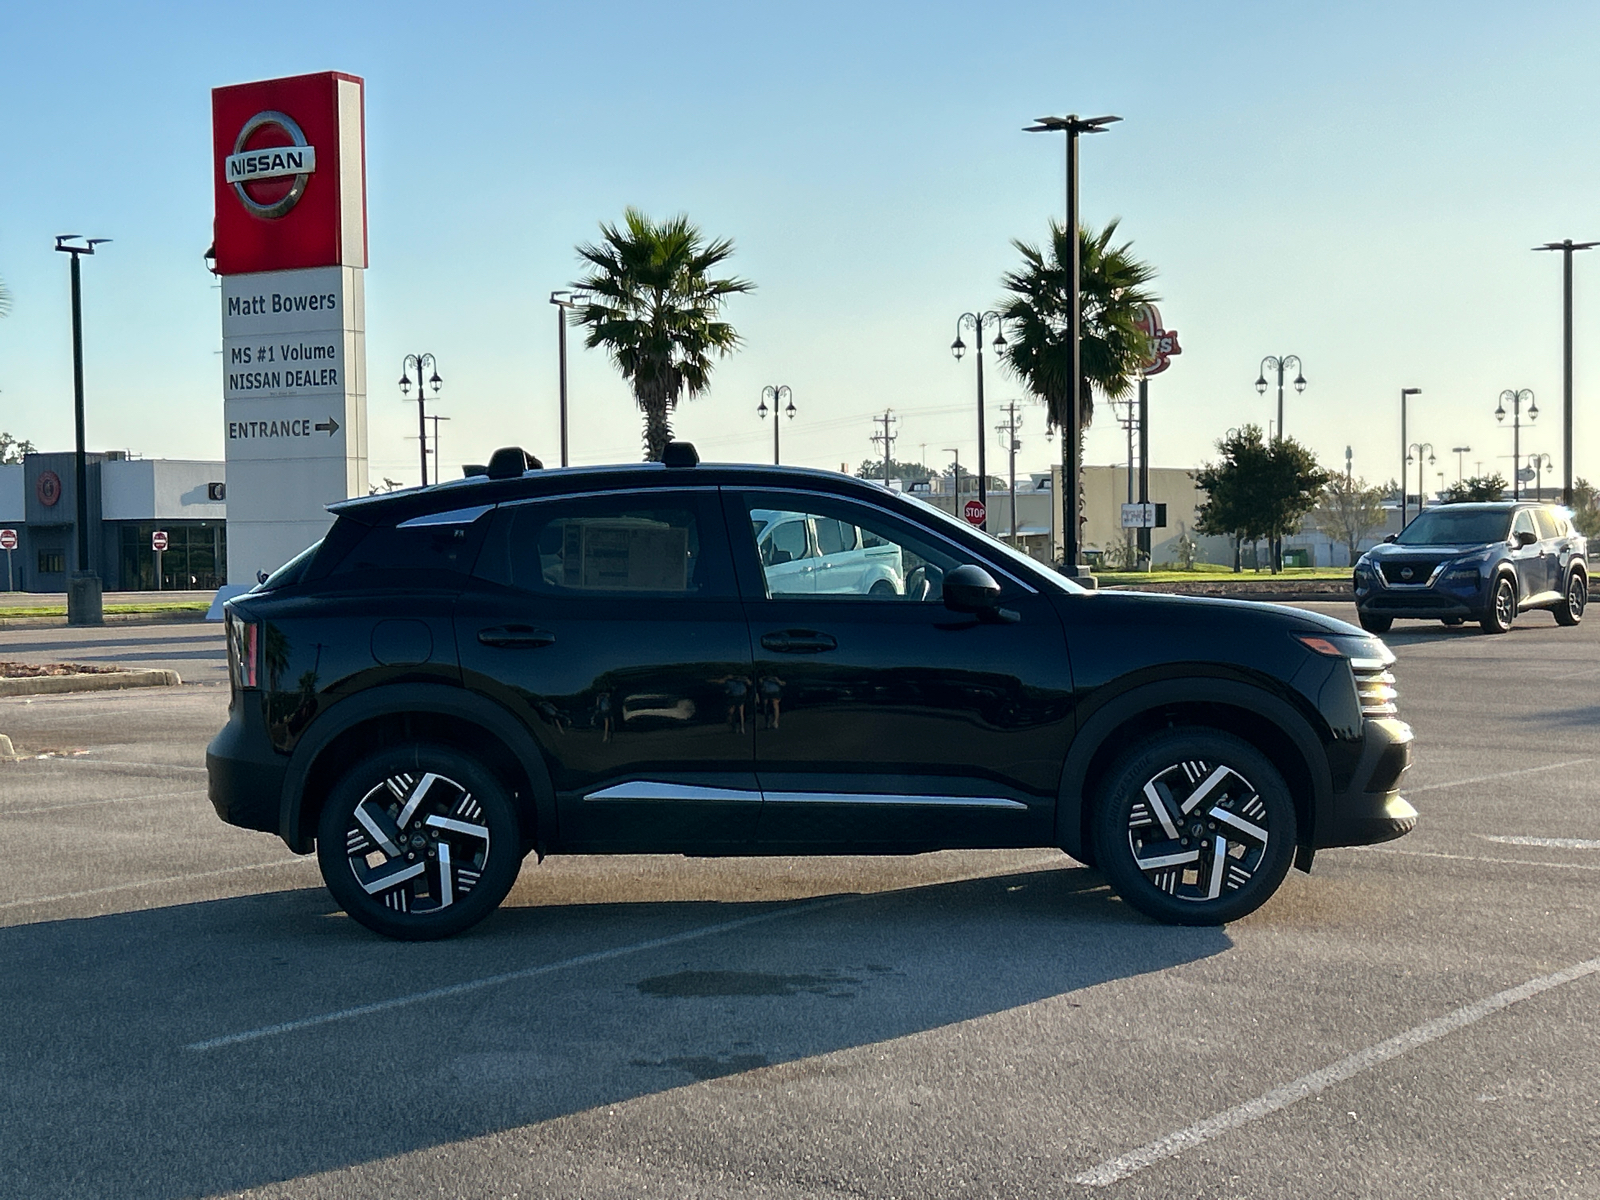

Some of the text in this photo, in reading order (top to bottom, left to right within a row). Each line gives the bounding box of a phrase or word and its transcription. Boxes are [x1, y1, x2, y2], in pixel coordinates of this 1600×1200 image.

[231, 151, 303, 176] NISSAN
[228, 293, 336, 316] Matt Bowers
[231, 343, 335, 365] MS #1 Volume
[229, 368, 338, 391] NISSAN DEALER
[229, 419, 310, 439] ENTRANCE
[965, 507, 985, 518] STOP
